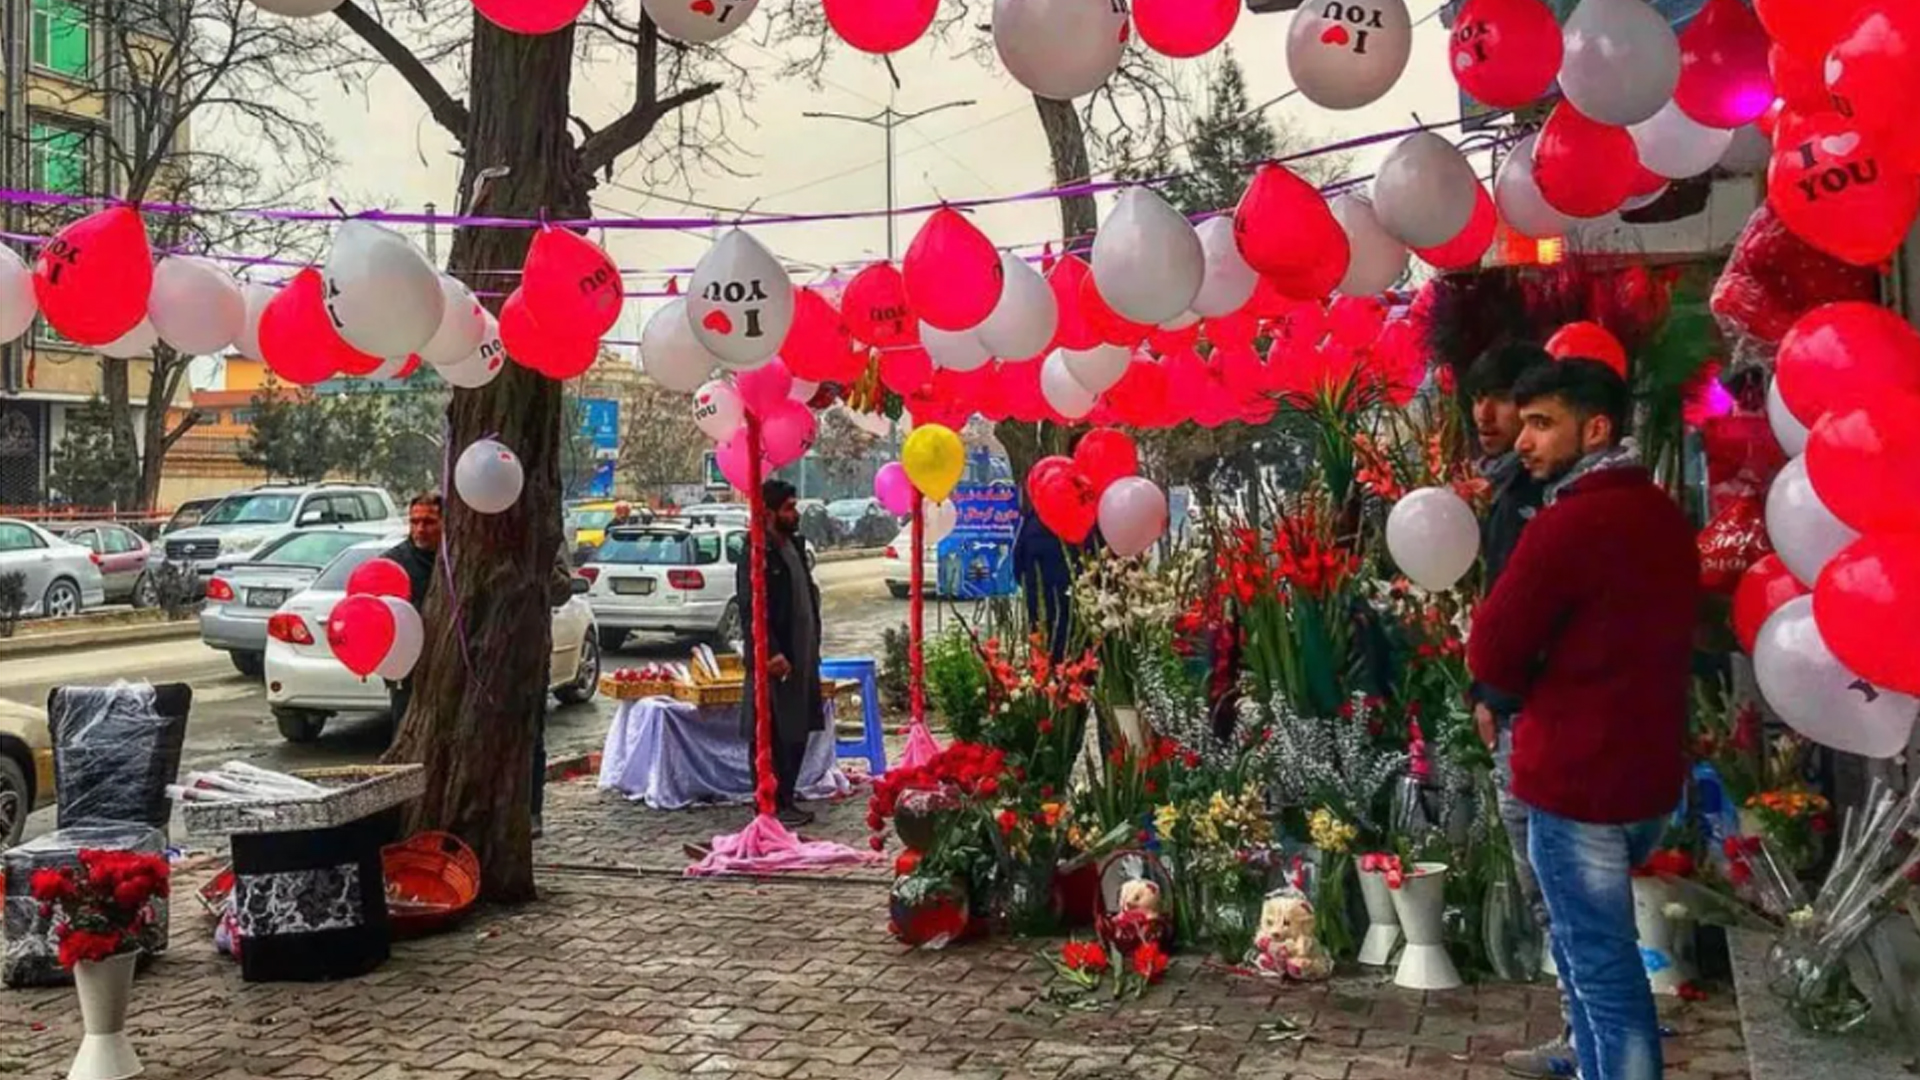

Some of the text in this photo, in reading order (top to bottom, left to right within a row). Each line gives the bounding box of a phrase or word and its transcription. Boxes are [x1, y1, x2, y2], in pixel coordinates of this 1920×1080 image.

[1322, 1, 1384, 28] YOU
[1352, 30, 1370, 54] I
[1798, 142, 1818, 168] I
[1797, 158, 1879, 202] YOU
[49, 263, 63, 285] I
[702, 279, 768, 303] YOU
[744, 308, 764, 337] I
[694, 403, 717, 421] YOU
